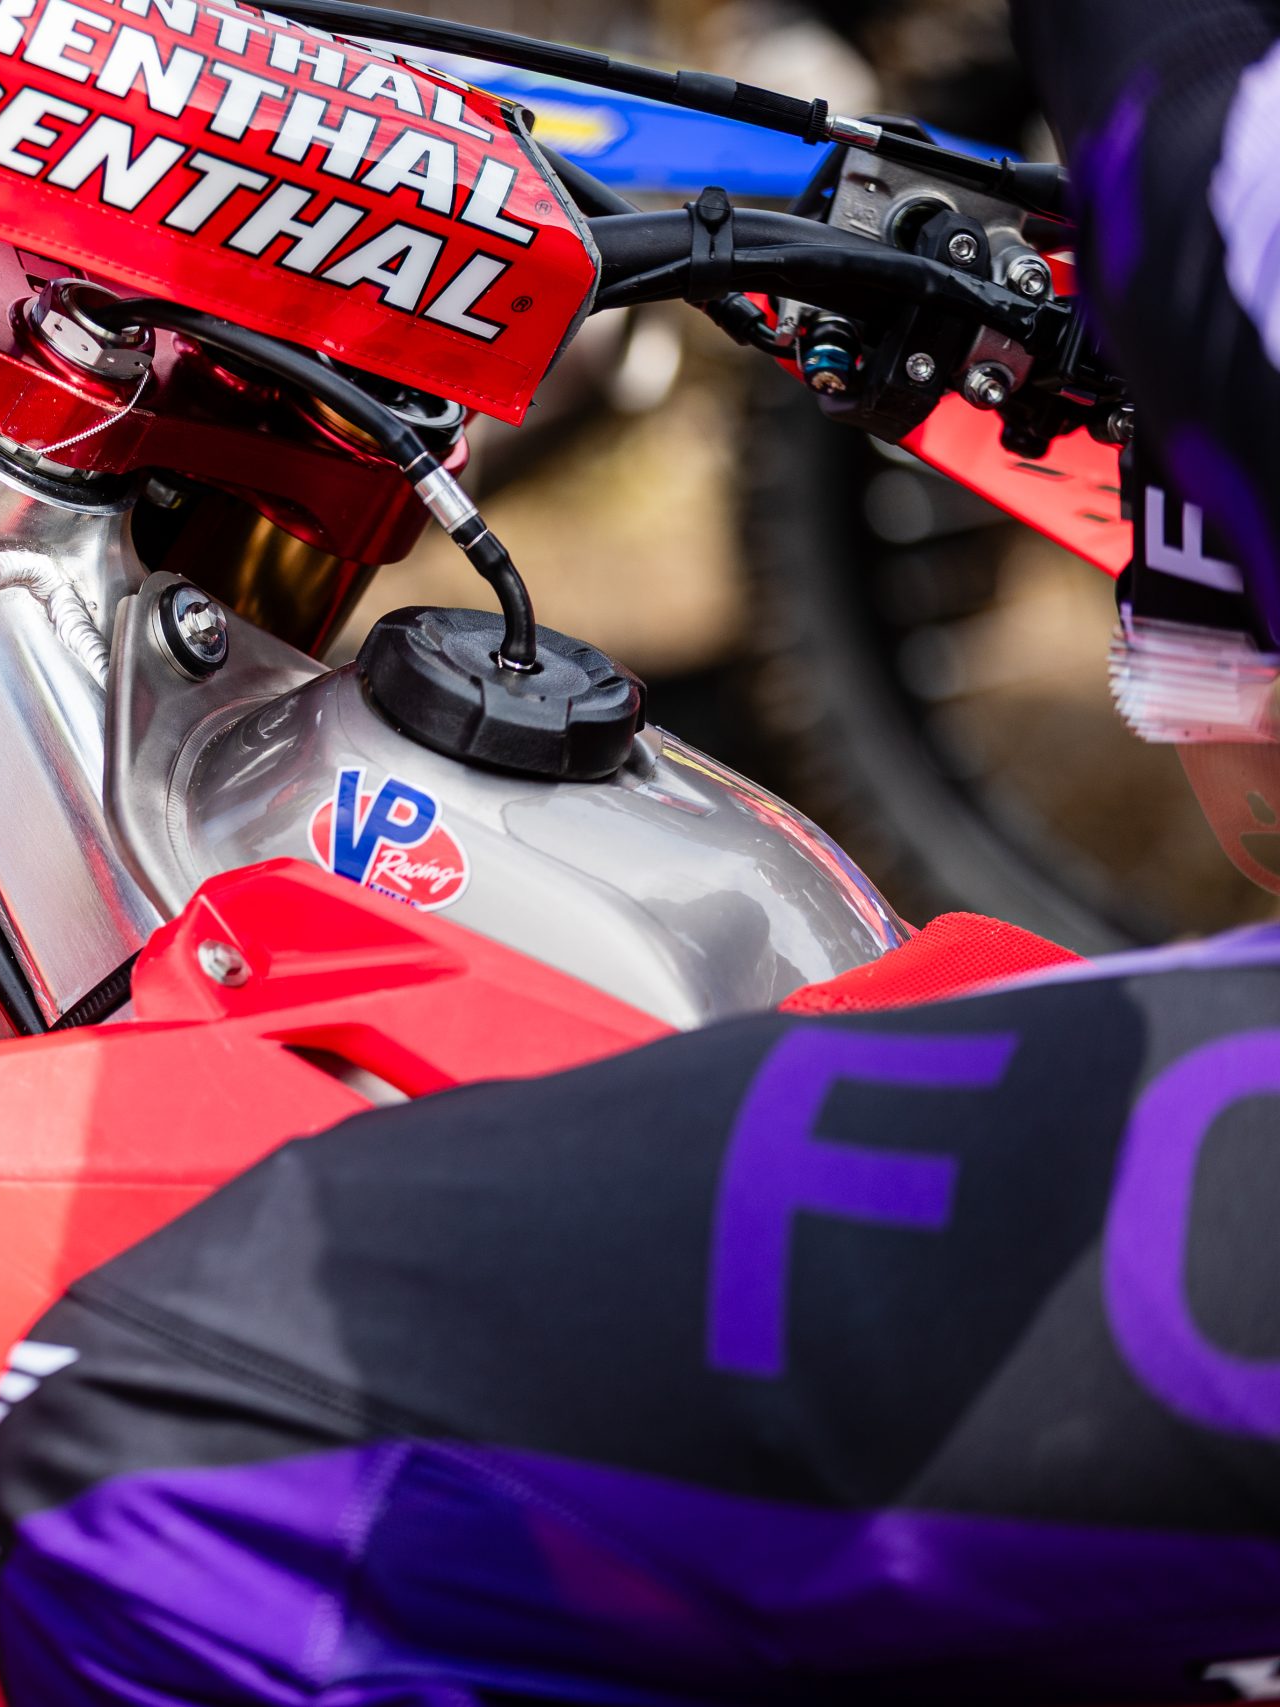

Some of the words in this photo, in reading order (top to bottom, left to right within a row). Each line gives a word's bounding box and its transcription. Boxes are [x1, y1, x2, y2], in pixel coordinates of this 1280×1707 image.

[100, 0, 494, 143] NTHAL
[332, 768, 438, 885] VP
[370, 848, 465, 895] Racing
